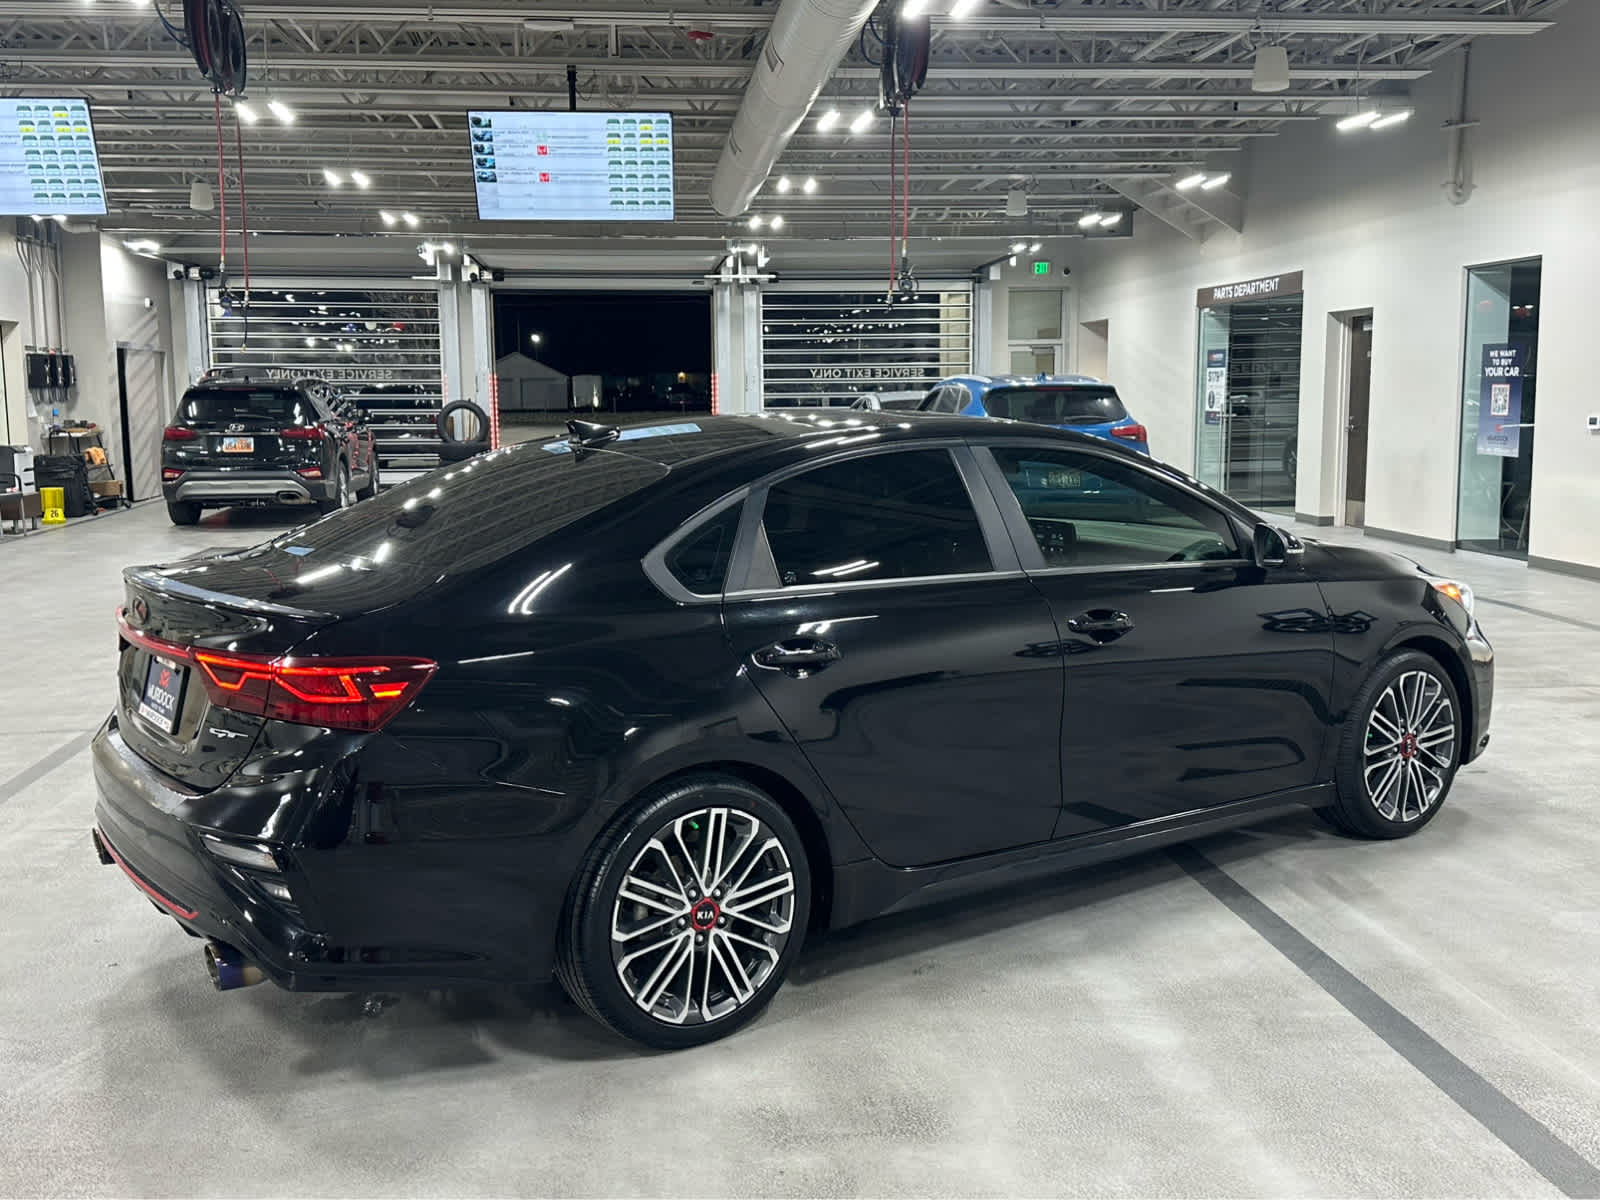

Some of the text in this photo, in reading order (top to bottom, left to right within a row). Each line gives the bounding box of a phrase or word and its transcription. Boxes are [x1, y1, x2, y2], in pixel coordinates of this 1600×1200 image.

[1213, 277, 1280, 300] PARTS DEPARTMENT
[1500, 349, 1517, 357] WANT
[1492, 358, 1513, 366] TO BUY
[1484, 366, 1520, 377] YOUR CAR
[209, 727, 248, 738] GT
